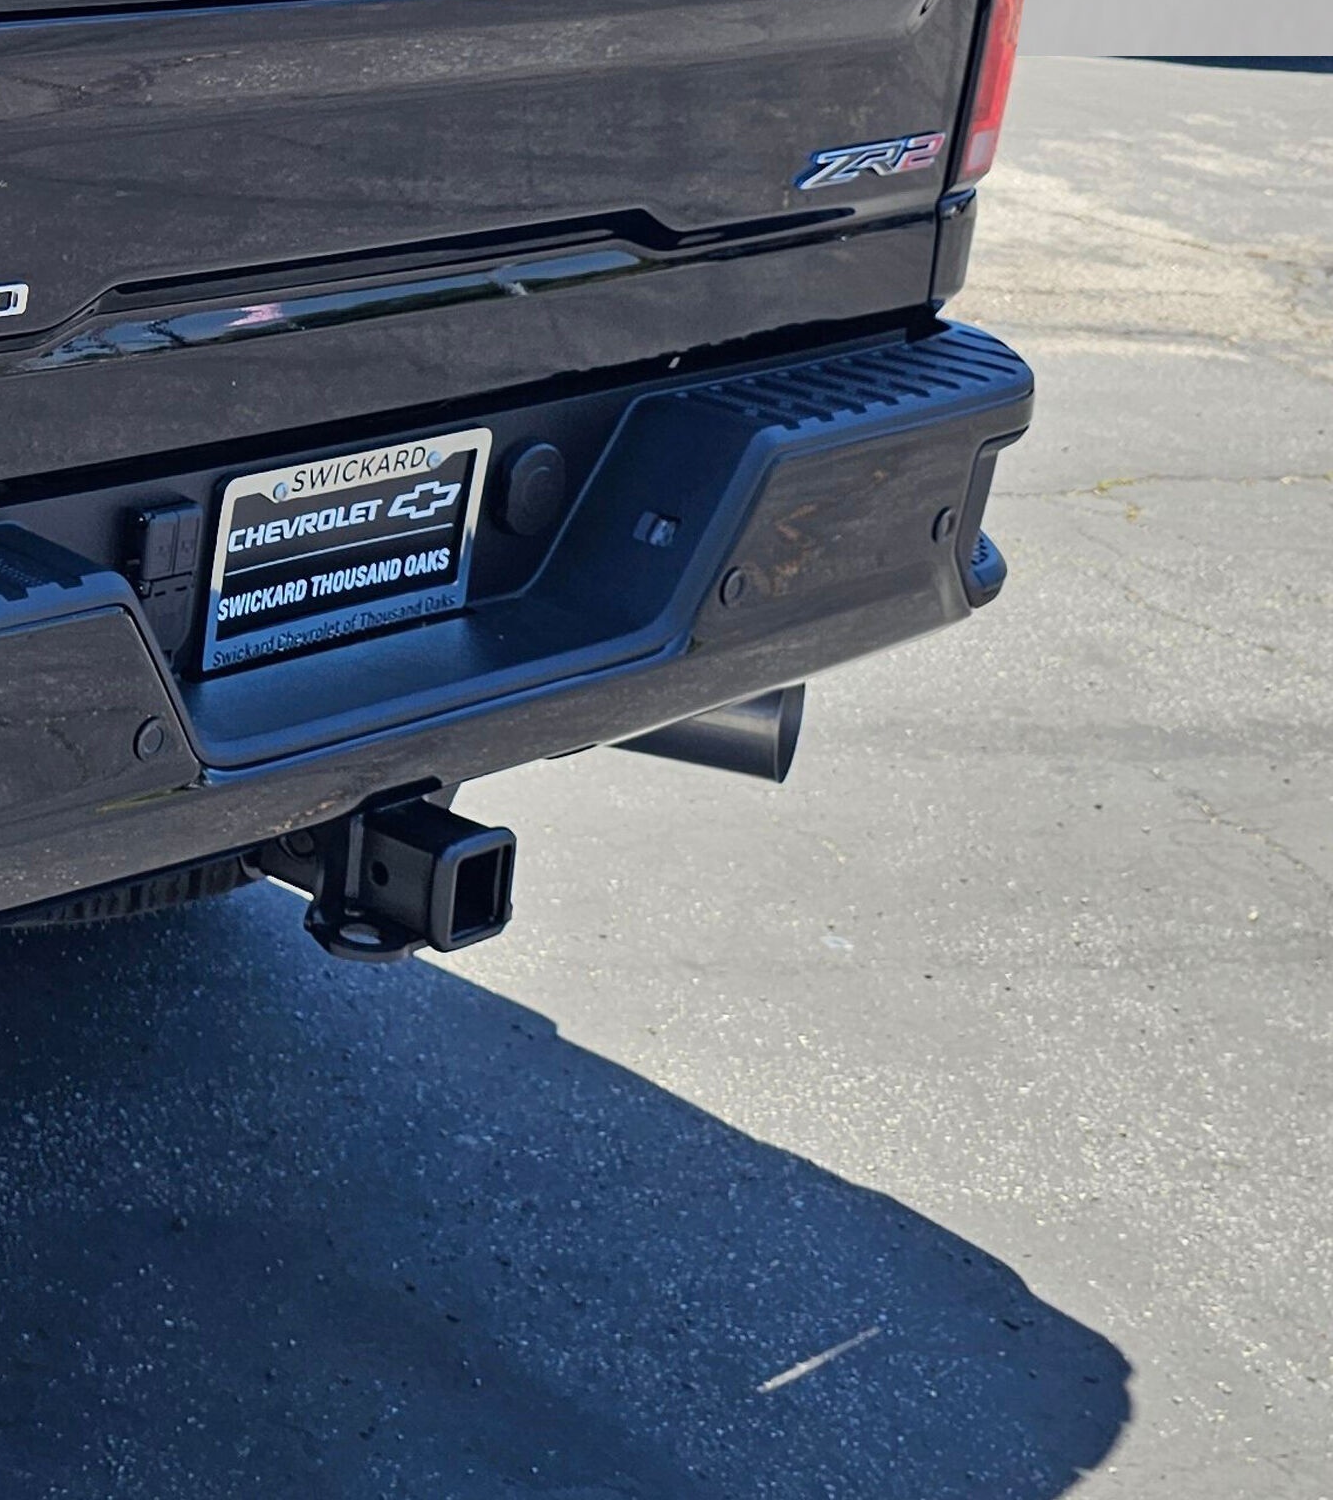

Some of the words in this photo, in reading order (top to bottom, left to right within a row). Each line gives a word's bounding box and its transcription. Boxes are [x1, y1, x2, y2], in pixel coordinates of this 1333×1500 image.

[794, 131, 946, 191] ZR2
[291, 445, 427, 493] SWICKARD
[228, 499, 383, 552] CHEVROLET
[217, 578, 308, 621] SWICKARD
[310, 557, 401, 598] THOUSAND
[404, 547, 451, 578] OAKS
[212, 636, 275, 668] Swickard
[277, 618, 340, 650] Chevrolet
[341, 612, 357, 634] of
[359, 600, 422, 630] Thousand
[424, 592, 457, 616] Oaks
